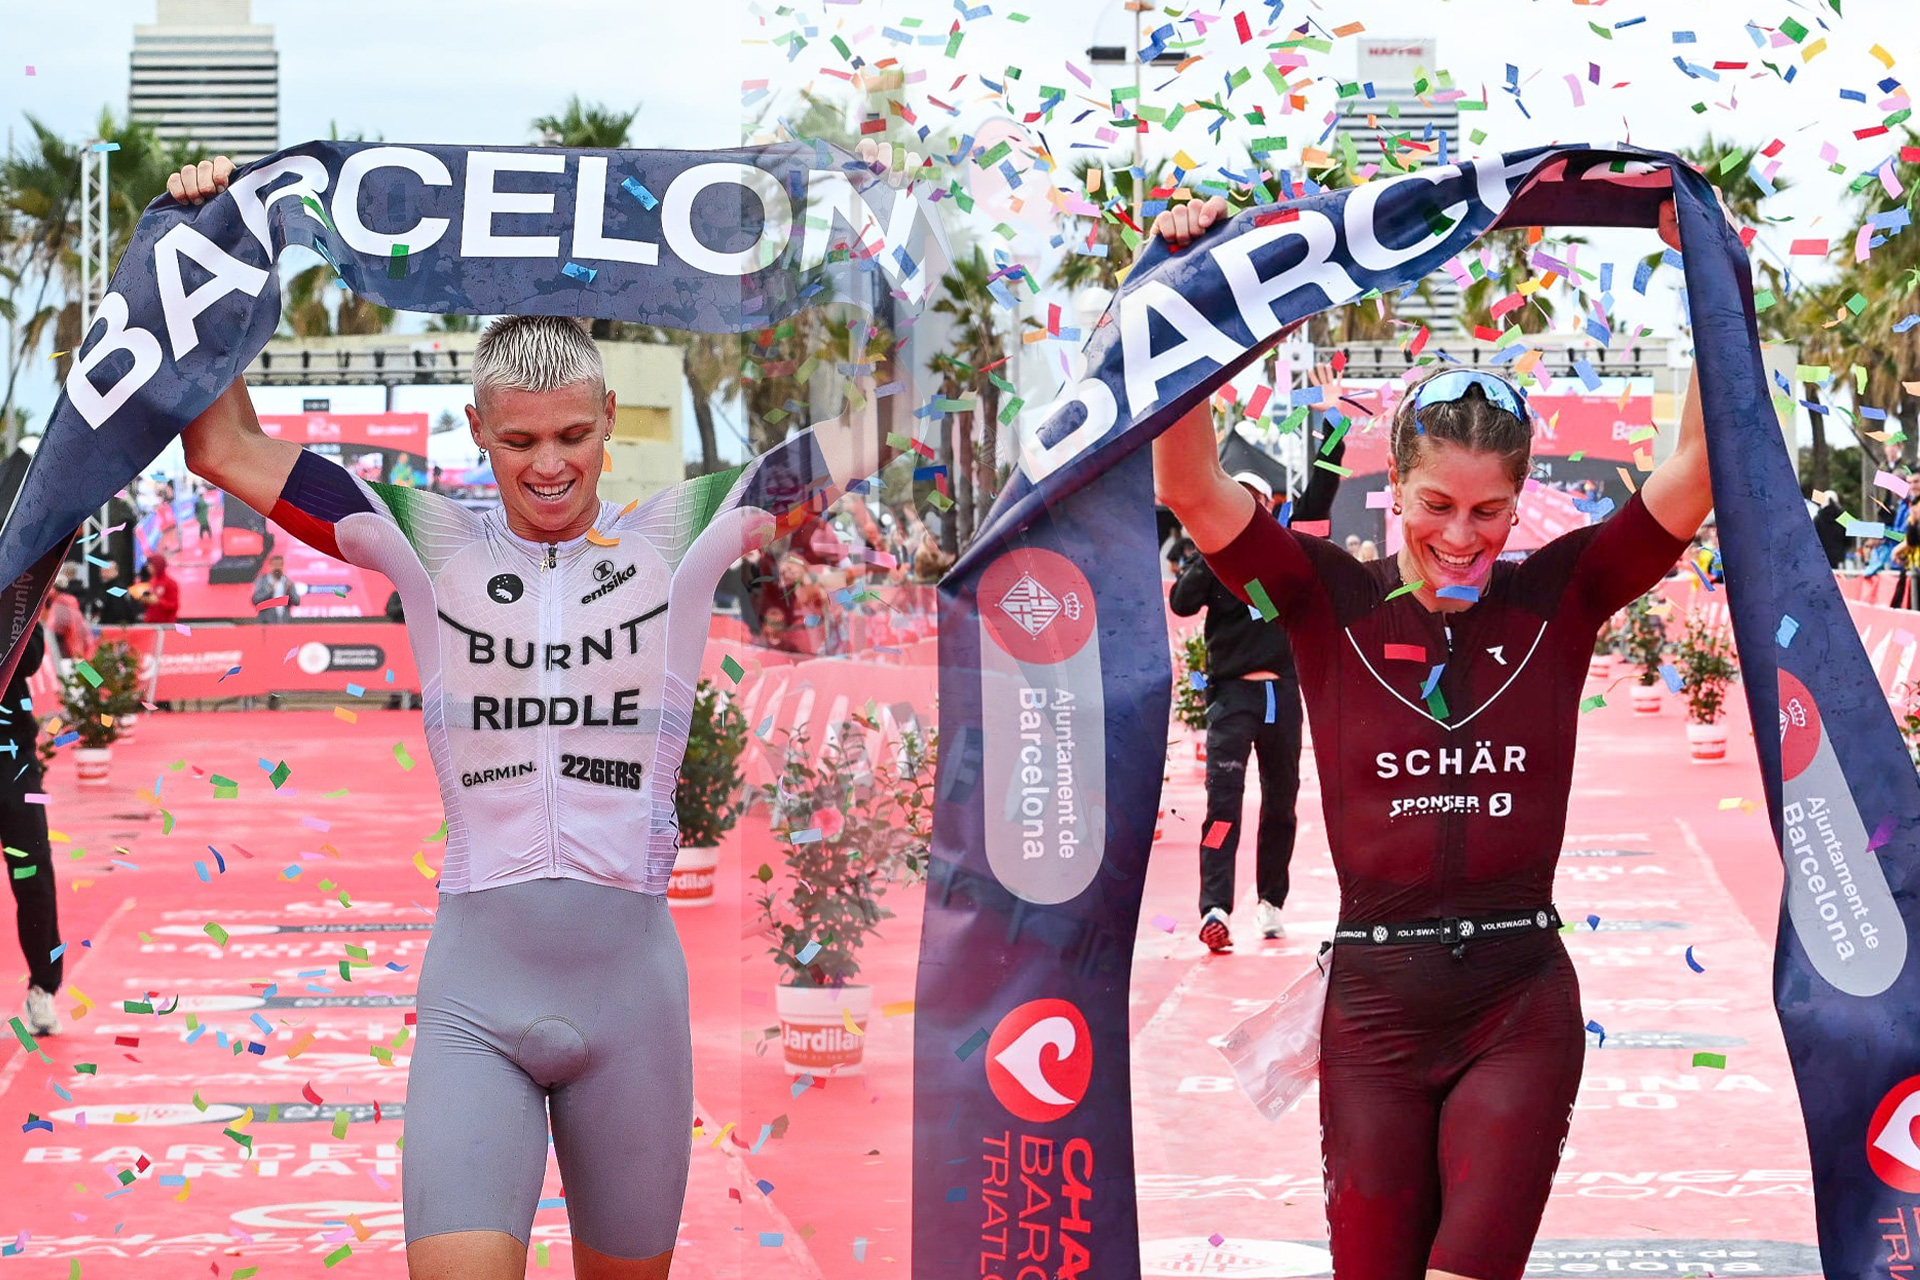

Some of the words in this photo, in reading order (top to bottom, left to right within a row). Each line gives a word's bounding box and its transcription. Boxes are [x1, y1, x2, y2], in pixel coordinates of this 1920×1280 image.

[66, 146, 926, 430] BARCELON
[581, 564, 637, 605] entsika
[450, 607, 662, 671] BURNT
[473, 688, 640, 731] RIDDLE
[462, 761, 537, 788] GARMIN
[561, 754, 642, 790] 226ERS
[1019, 686, 1050, 861] Barcelona
[1050, 688, 1079, 826] Ajuntament
[1376, 740, 1527, 779] SCHÄR
[1389, 795, 1480, 818] SPONSER
[1058, 830, 1080, 860] de
[1783, 801, 1856, 962] Barcelona
[1806, 796, 1869, 920] Ajuntament
[1859, 921, 1880, 950] de
[1481, 918, 1532, 931] VOLKSWAGEN
[981, 1131, 1010, 1280] TRIATL
[1878, 1207, 1915, 1280] TRI
